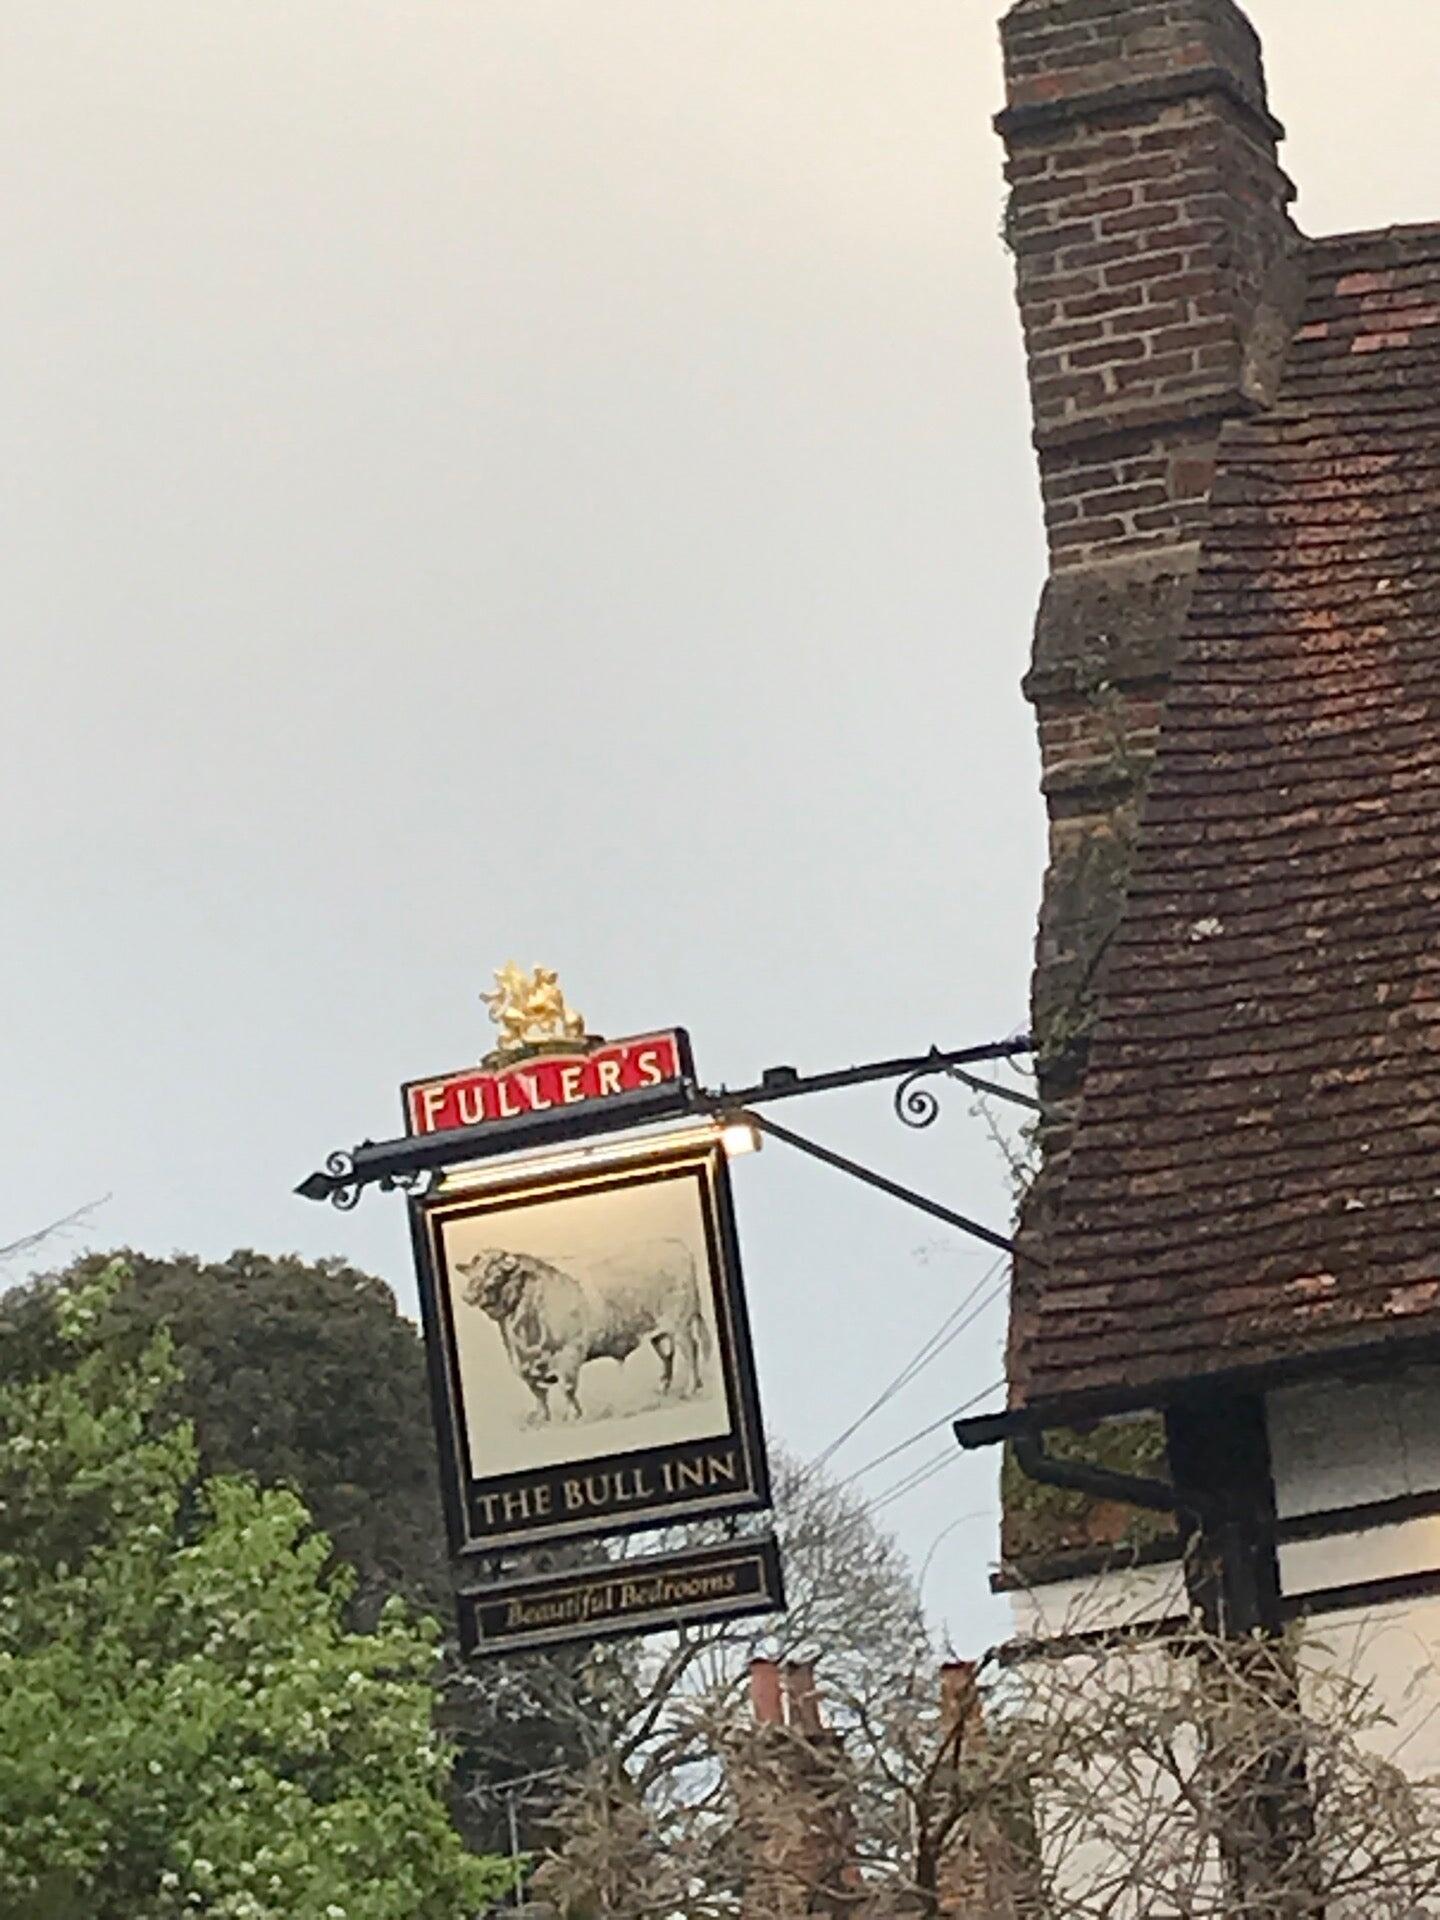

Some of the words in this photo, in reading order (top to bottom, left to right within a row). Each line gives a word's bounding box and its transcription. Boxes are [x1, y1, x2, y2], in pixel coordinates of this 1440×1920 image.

[422, 1046, 662, 1131] FULLER'S
[477, 1485, 552, 1525] THE
[563, 1467, 654, 1510] BULL
[662, 1452, 737, 1492] INN
[506, 1587, 612, 1627] Beautiful
[621, 1571, 736, 1608] Bedrooms
